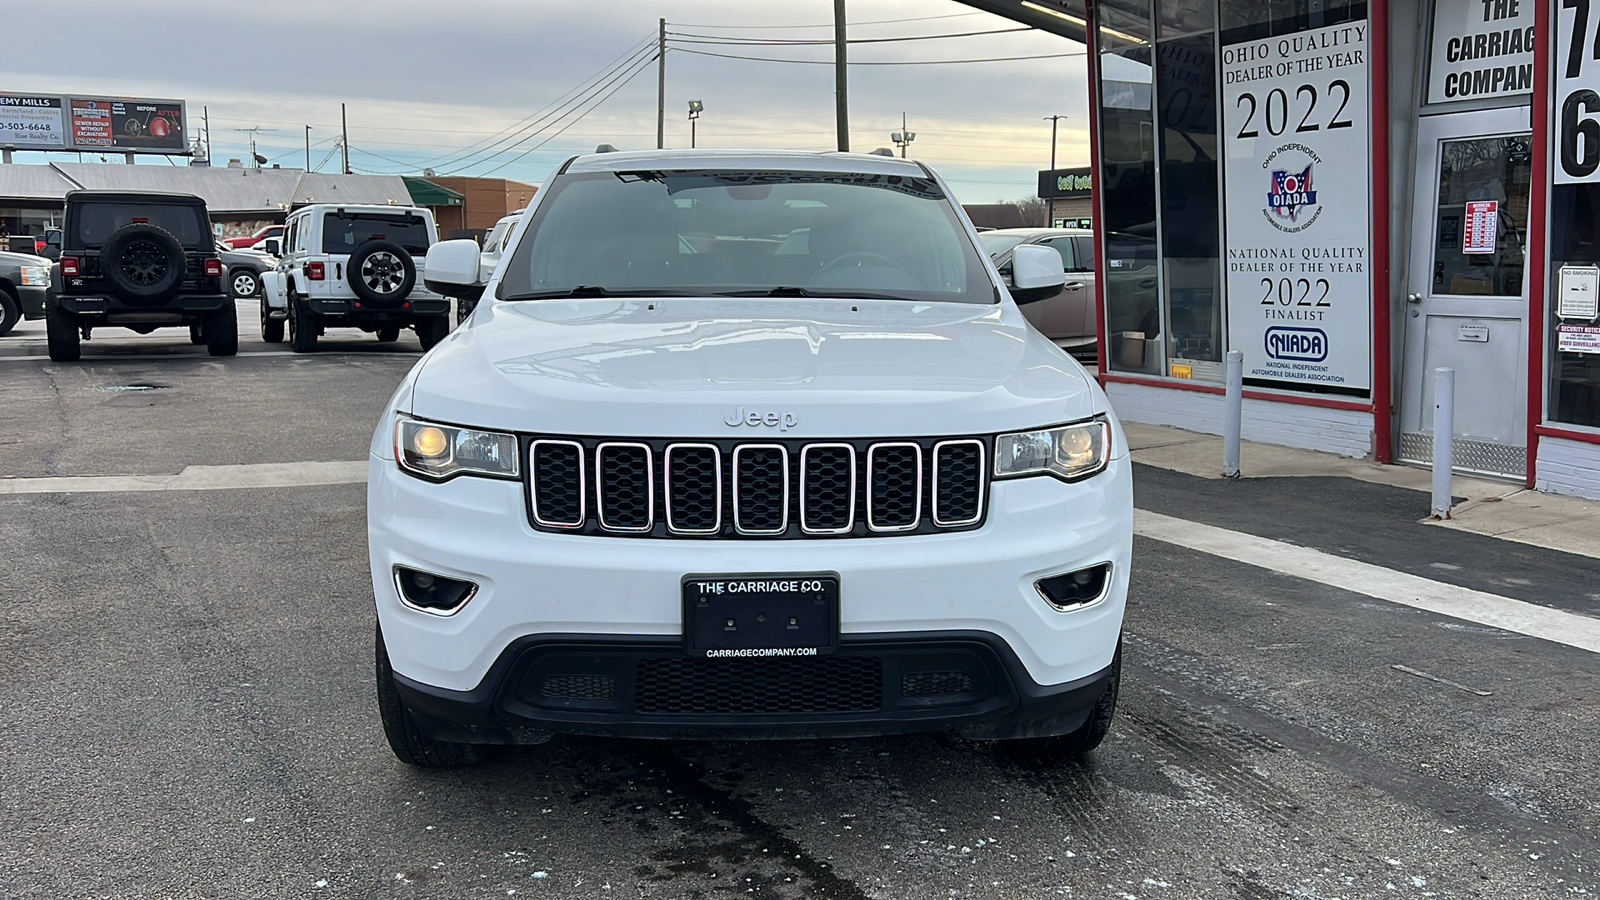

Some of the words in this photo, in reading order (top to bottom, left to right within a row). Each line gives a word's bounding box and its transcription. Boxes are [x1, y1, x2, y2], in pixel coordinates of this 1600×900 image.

[1482, 0, 1519, 22] THE
[1223, 43, 1269, 65] OHIO
[1278, 25, 1366, 58] QUALITY
[1447, 26, 1535, 63] CARRIAG
[1226, 65, 1273, 85] DEALER
[1276, 61, 1293, 77] OF
[1295, 56, 1323, 74] THE
[1327, 50, 1364, 69] YEAR
[1445, 64, 1533, 98] COMPAN
[22, 98, 51, 107] MILLS
[1236, 79, 1353, 139] 2022
[29, 132, 49, 142] Realty
[1561, 89, 1600, 178] 6
[1262, 150, 1277, 169] OHIO
[1276, 143, 1322, 165] INDEPENDENT
[1273, 192, 1309, 206] OIADA
[1262, 208, 1283, 232] AUTOMOBILE
[1282, 226, 1301, 234] DEALERS
[1300, 205, 1323, 231] ASSOCIATION
[1229, 248, 1296, 259] NATIONAL
[1301, 247, 1365, 260] QUALITY
[1231, 262, 1275, 273] DEALER
[1279, 262, 1295, 273] OF
[1300, 262, 1324, 273] THE
[1329, 262, 1363, 273] YEAR
[1260, 277, 1331, 307] 2022
[1265, 309, 1325, 321] FINALIST
[1560, 325, 1584, 333] SECURITY
[1269, 333, 1322, 355] NIADA
[1251, 369, 1283, 378] AUTOMOBILE
[1284, 371, 1307, 380] DEALERS
[1307, 373, 1345, 383] ASSOCIATION
[1266, 362, 1291, 370] NATIONAL
[1292, 363, 1328, 373] INDEPENDENT
[724, 406, 798, 431] Jeep
[698, 582, 725, 594] THE
[728, 581, 798, 593] CARRIAGE
[801, 580, 825, 593] CO.
[706, 647, 817, 658] CARRIAGECOMPANY.COM
